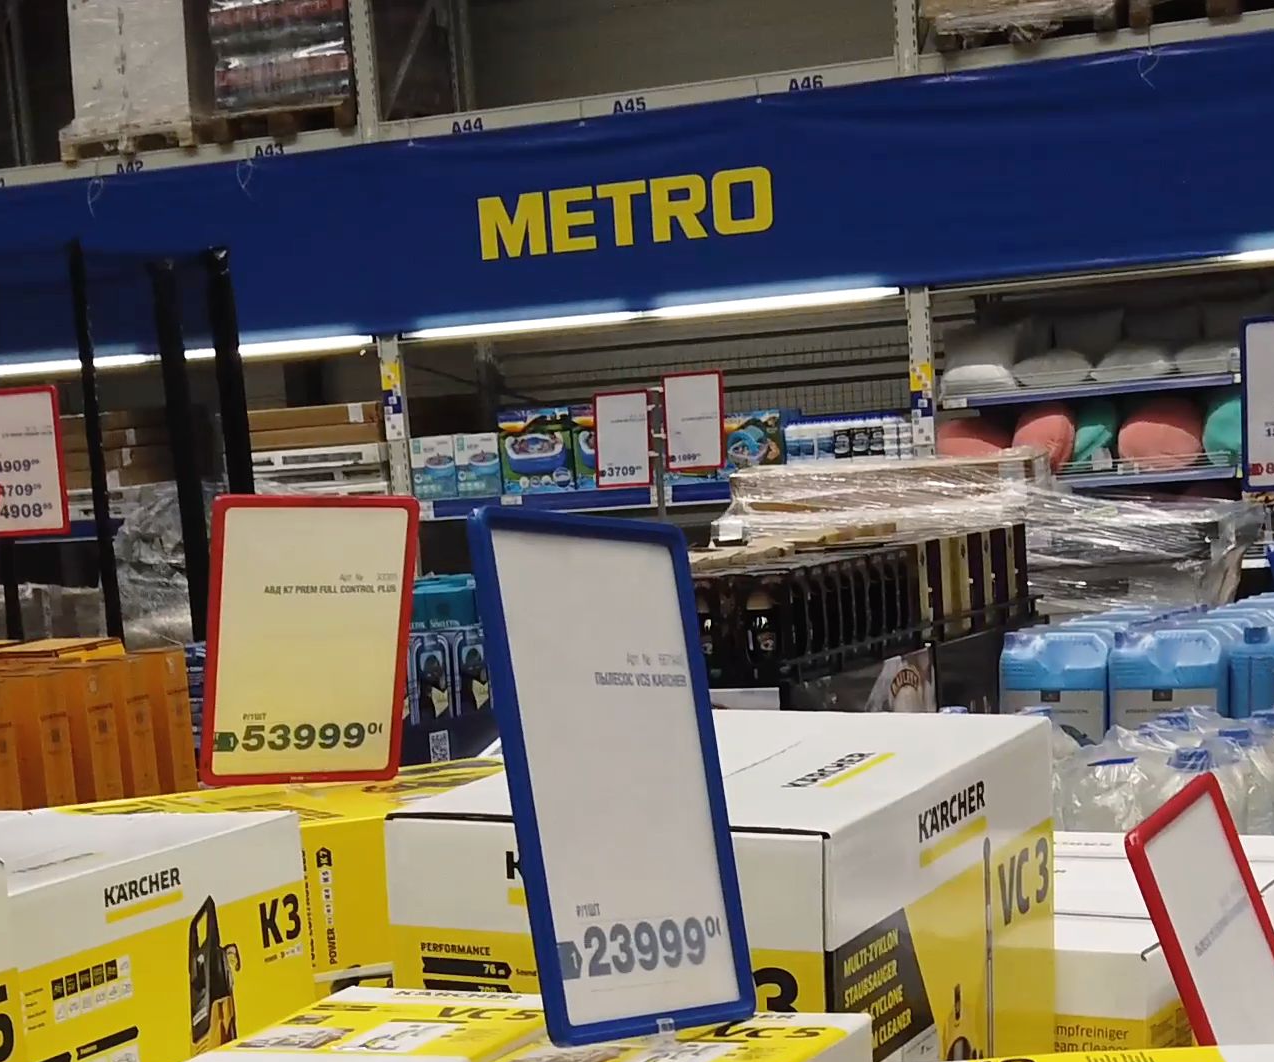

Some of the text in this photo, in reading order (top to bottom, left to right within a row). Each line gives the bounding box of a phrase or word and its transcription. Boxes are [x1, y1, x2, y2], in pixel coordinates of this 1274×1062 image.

[788, 75, 824, 92] A46
[612, 97, 647, 115] A45
[452, 117, 484, 134] A44
[477, 166, 774, 260] METRO
[340, 585, 375, 594] CONTROL
[242, 722, 365, 751] 53999
[918, 781, 986, 844] KÄRCHER
[104, 867, 181, 907] KÄRCHER
[259, 893, 302, 948] K3
[327, 928, 338, 965] POWER
[421, 942, 491, 956] PERFORMANCE
[584, 917, 706, 977] 23999
[843, 928, 899, 979] MULTI-ZYKLON
[483, 964, 496, 974] 76
[1056, 1023, 1129, 1042] mpfreiniger
